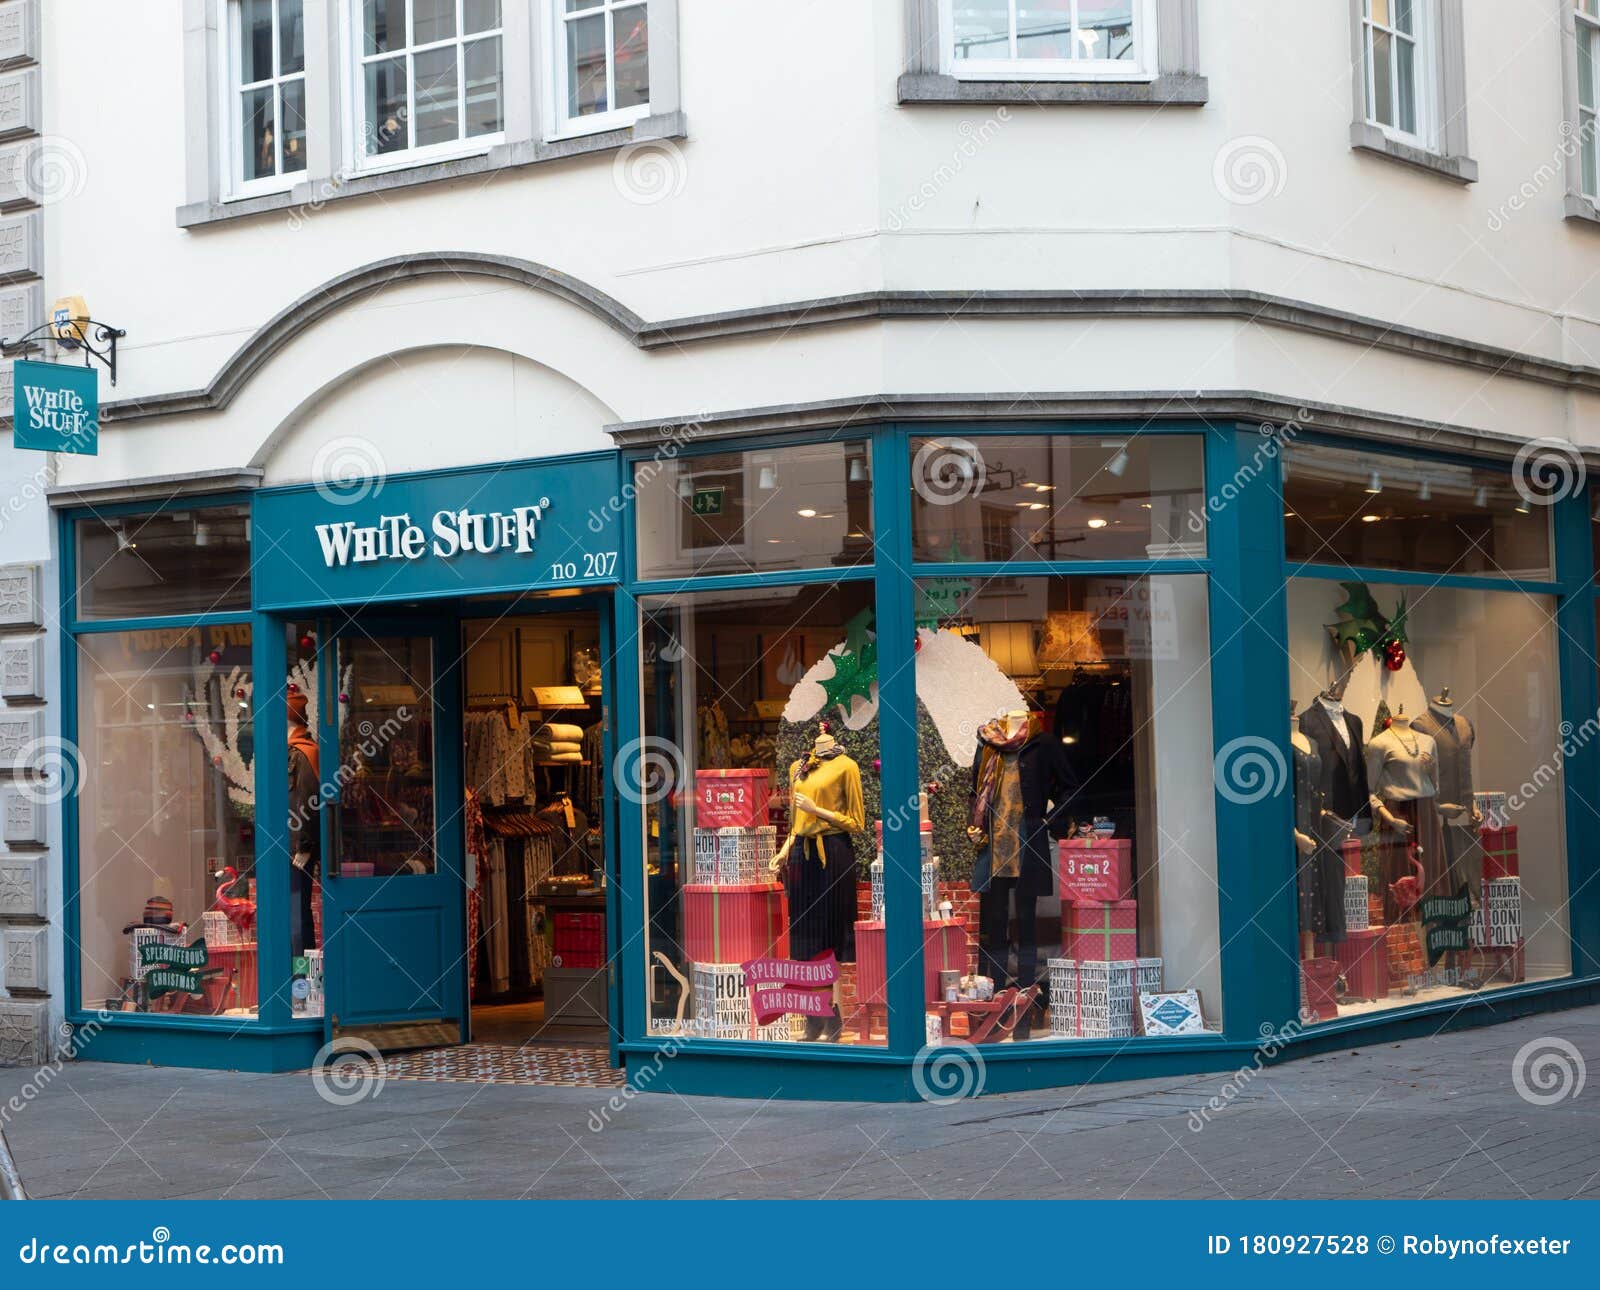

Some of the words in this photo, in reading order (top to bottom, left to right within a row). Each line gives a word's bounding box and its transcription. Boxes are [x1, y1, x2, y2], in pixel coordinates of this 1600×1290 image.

[551, 561, 577, 580] no
[583, 551, 618, 577] 207
[705, 788, 713, 803] 3
[737, 787, 745, 803] 2
[1067, 859, 1076, 875] 3
[1102, 859, 1110, 875] 2
[145, 946, 206, 965] SPLENDIFEROUS
[152, 972, 197, 991] CHRISTMAS
[750, 962, 834, 982] SPLENDIFEROUS
[761, 992, 821, 1012] CHRISTMAS
